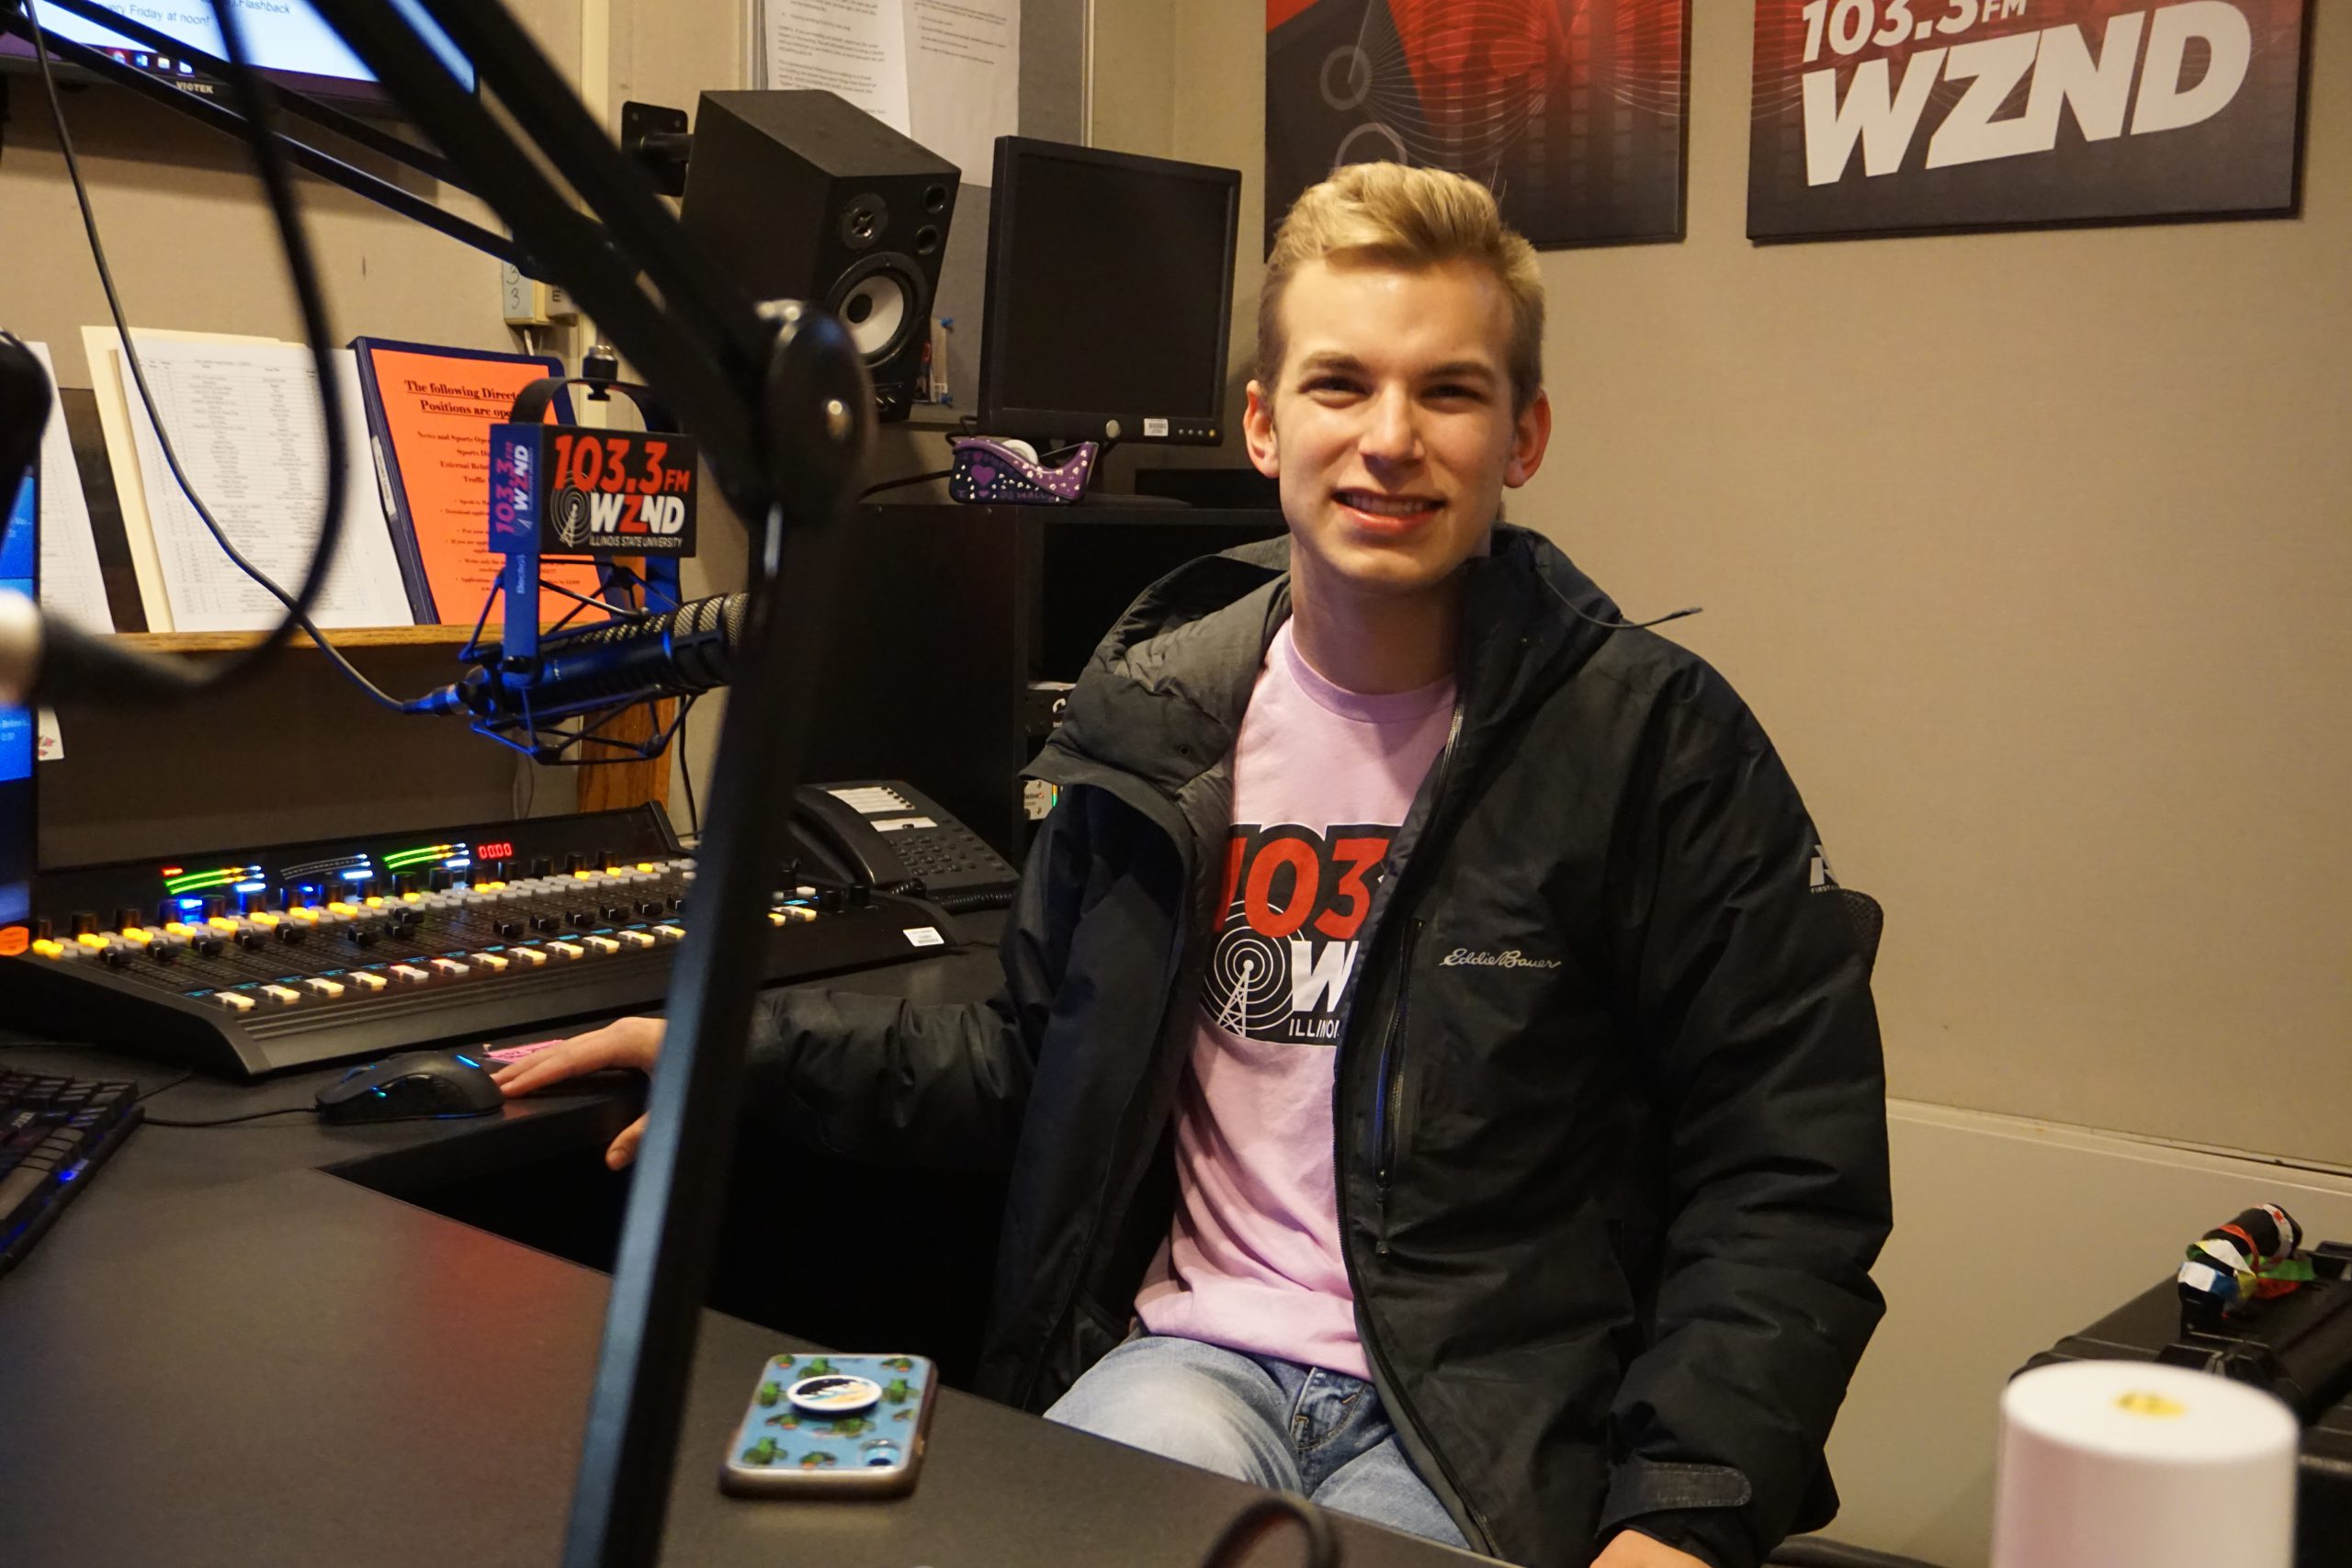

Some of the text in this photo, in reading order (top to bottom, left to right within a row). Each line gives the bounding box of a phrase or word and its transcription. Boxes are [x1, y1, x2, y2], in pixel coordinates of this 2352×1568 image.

[1802, 0, 2253, 187] WZND
[404, 379, 518, 401] The following Direct
[420, 400, 472, 414] Positions
[474, 407, 491, 416] are
[590, 492, 685, 534] WZND
[620, 536, 643, 547] STATE
[643, 536, 684, 548] UNIVERSITY
[1289, 1018, 1340, 1039] ILLINOI
